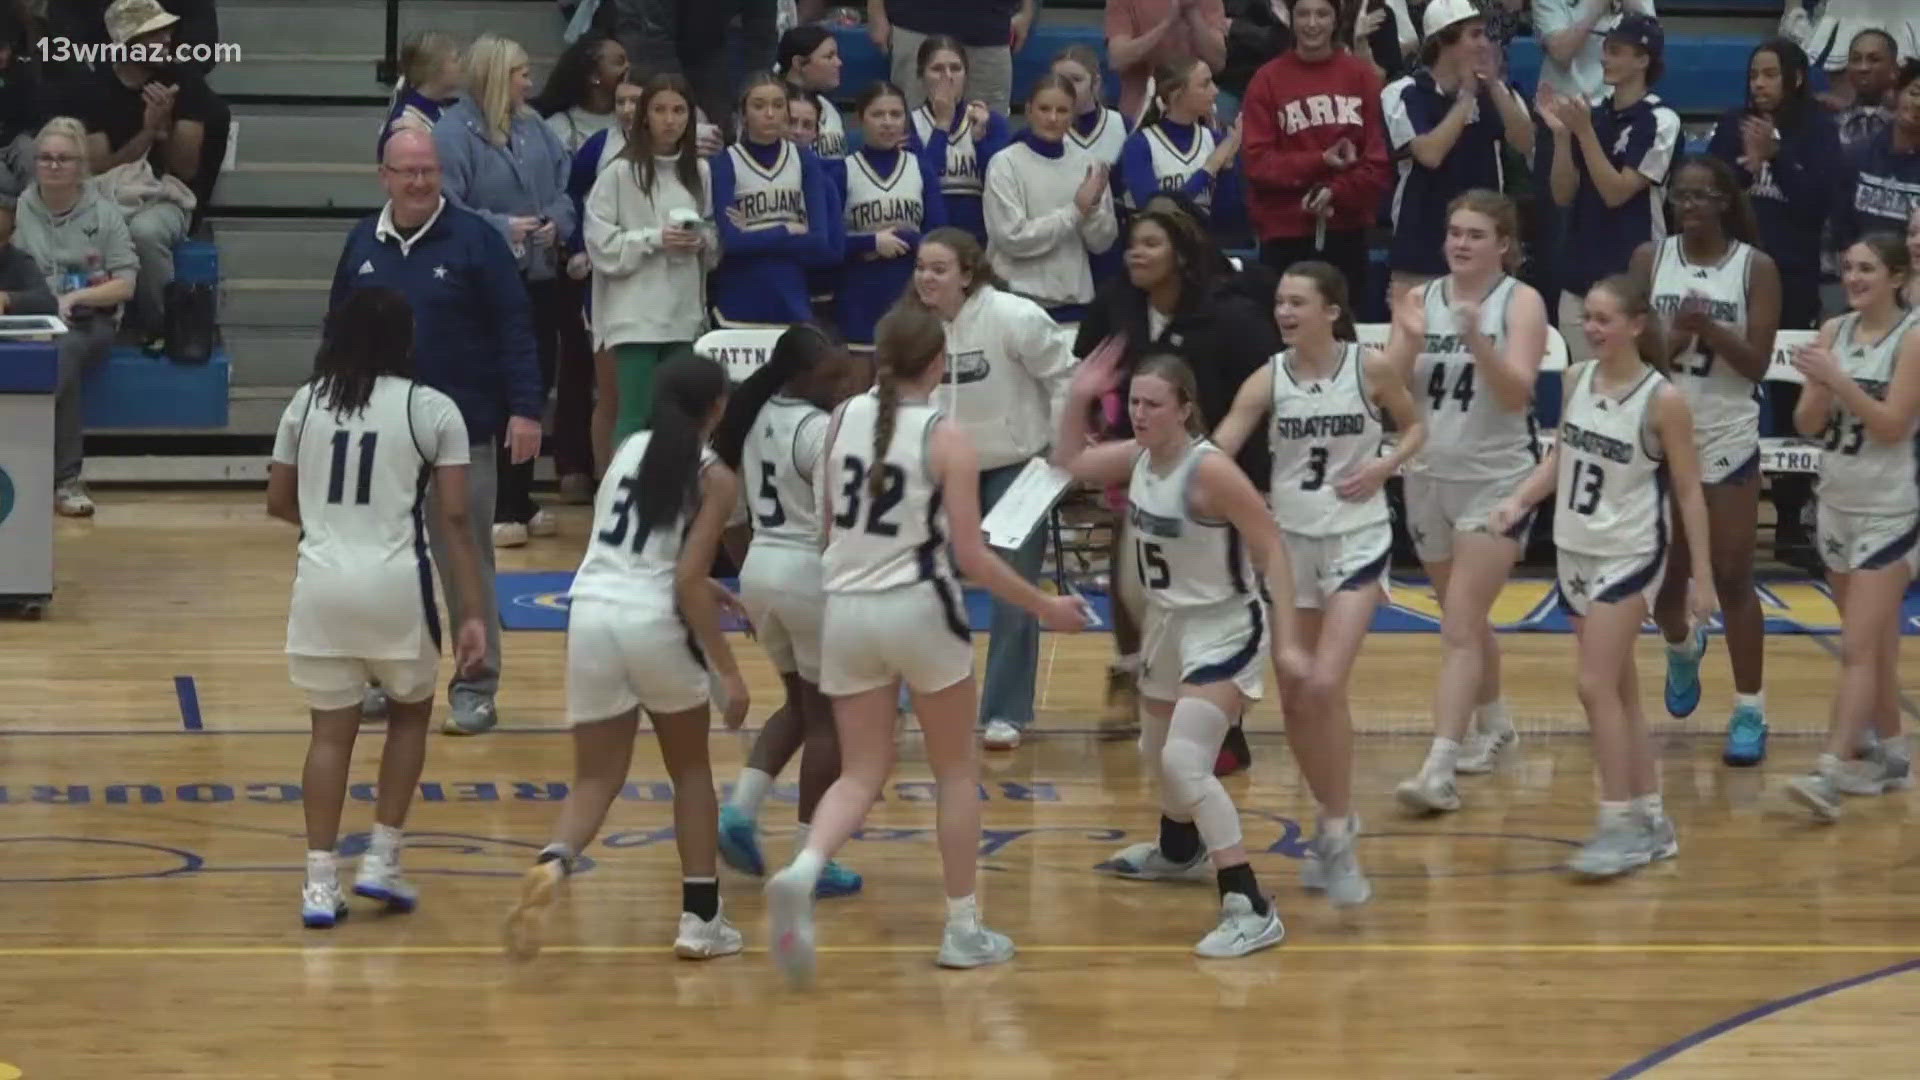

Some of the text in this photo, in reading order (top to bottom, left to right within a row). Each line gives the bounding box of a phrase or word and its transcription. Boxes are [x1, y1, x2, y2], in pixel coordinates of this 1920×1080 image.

[851, 200, 922, 227] TROJANS
[1428, 361, 1475, 412] 44
[1277, 413, 1364, 439] STRATFORD
[326, 430, 378, 505] 11
[759, 460, 786, 528] 5
[1300, 446, 1328, 491] 3
[1568, 458, 1604, 515] 13
[836, 454, 906, 537] 32
